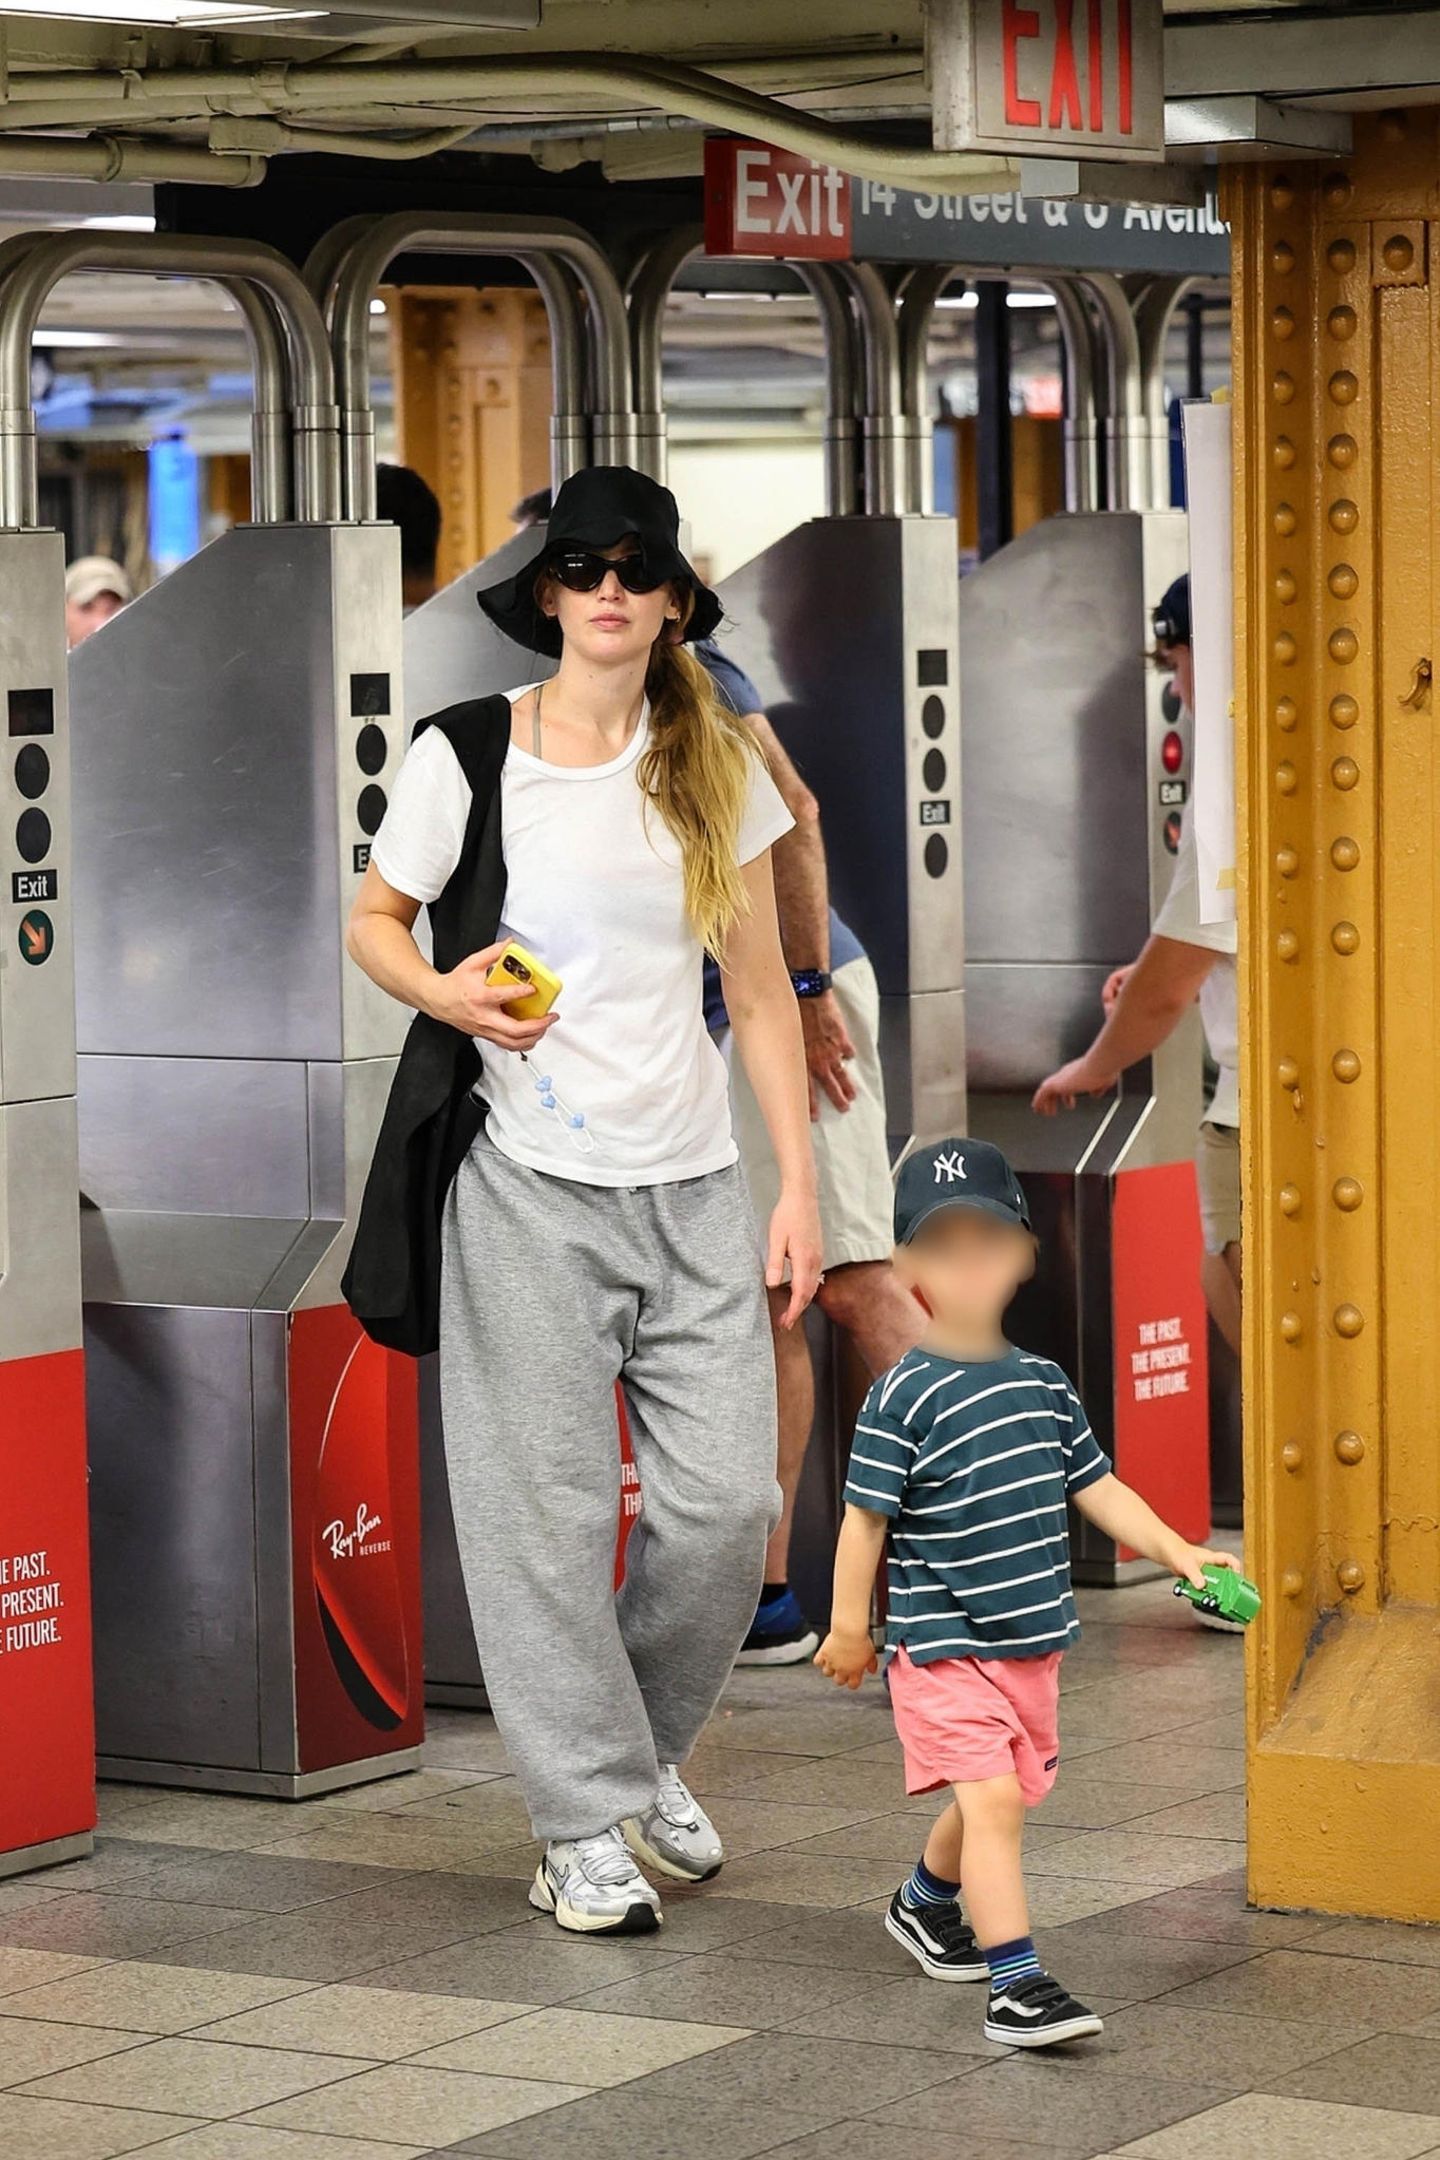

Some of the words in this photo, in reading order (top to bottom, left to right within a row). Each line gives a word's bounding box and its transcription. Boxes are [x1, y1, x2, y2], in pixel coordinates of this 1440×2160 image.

[736, 150, 844, 237] Exit
[861, 178, 897, 216] 14
[1123, 193, 1231, 235] venu
[17, 875, 48, 899] Exit
[933, 1151, 968, 1184] NY
[13, 1551, 51, 1582] PAST.
[1, 1582, 64, 1619] PRESENT.
[6, 1617, 62, 1652] FUTURE.
